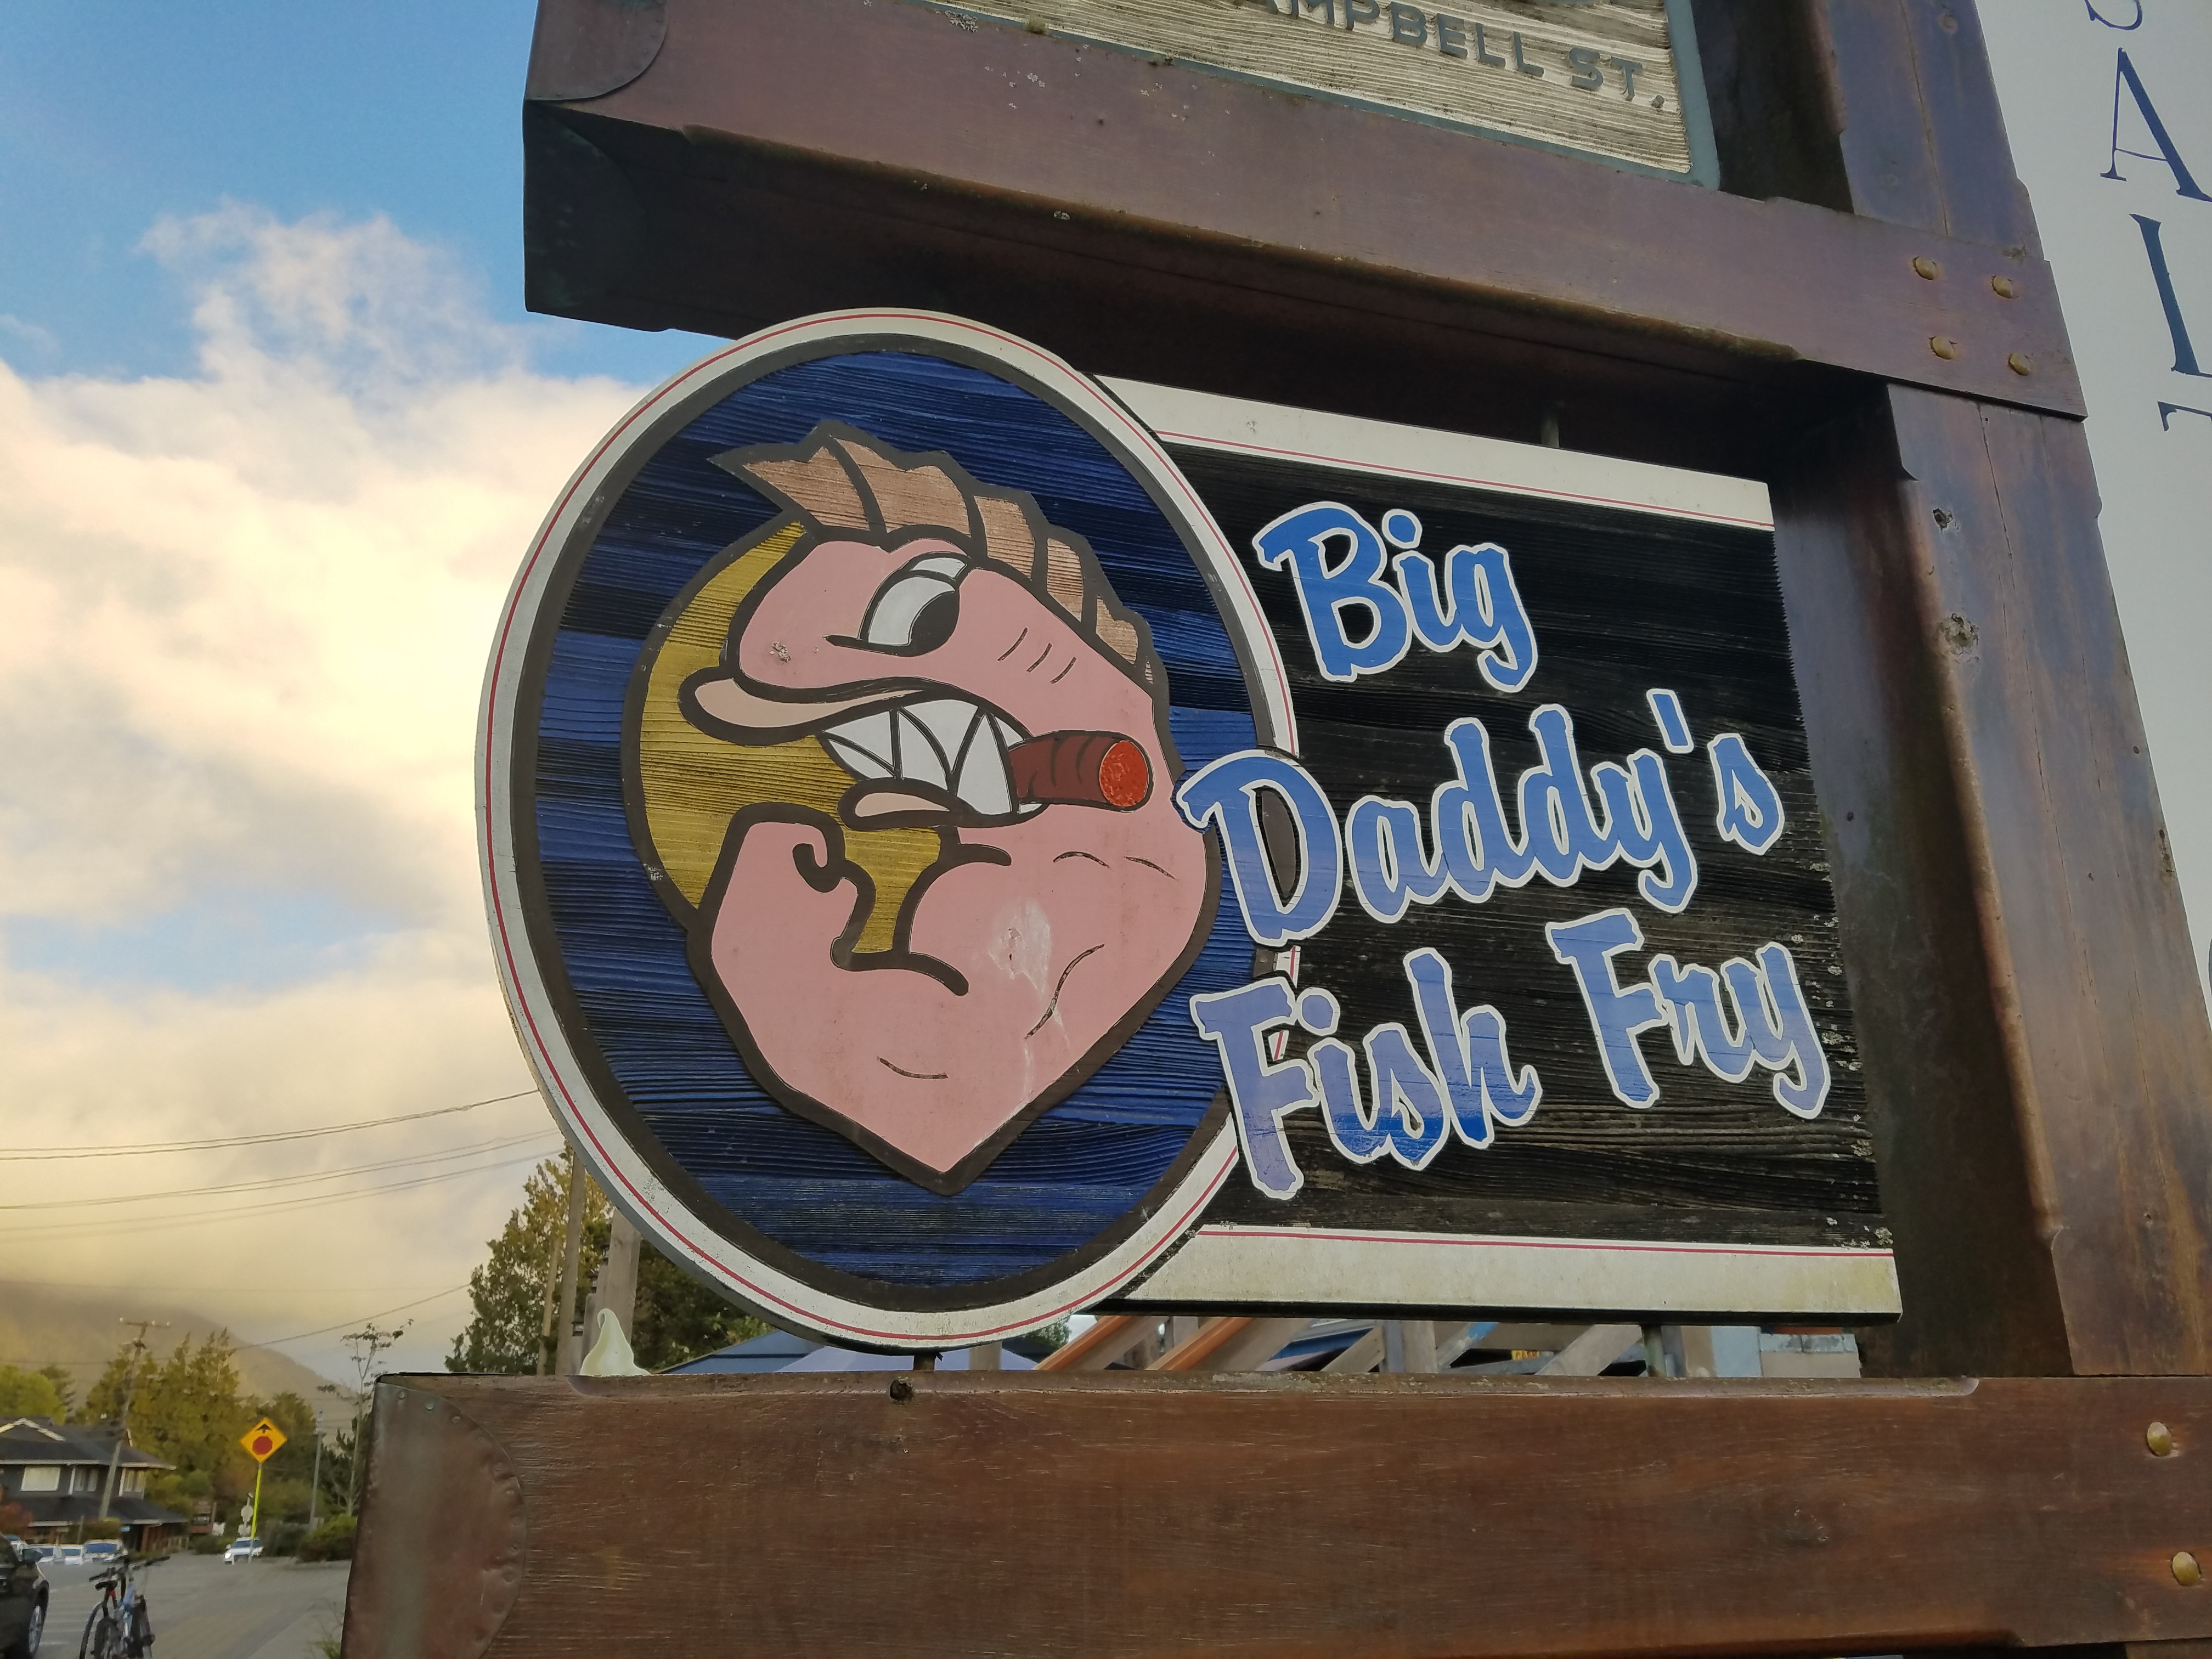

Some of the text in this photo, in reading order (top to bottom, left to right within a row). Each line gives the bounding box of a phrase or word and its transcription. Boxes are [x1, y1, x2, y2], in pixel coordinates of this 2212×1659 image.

[1566, 46, 1665, 109] ST.
[1253, 500, 1538, 693] Big
[1174, 689, 1785, 947] Daddy's
[1189, 908, 1831, 1200] Fish Fry
